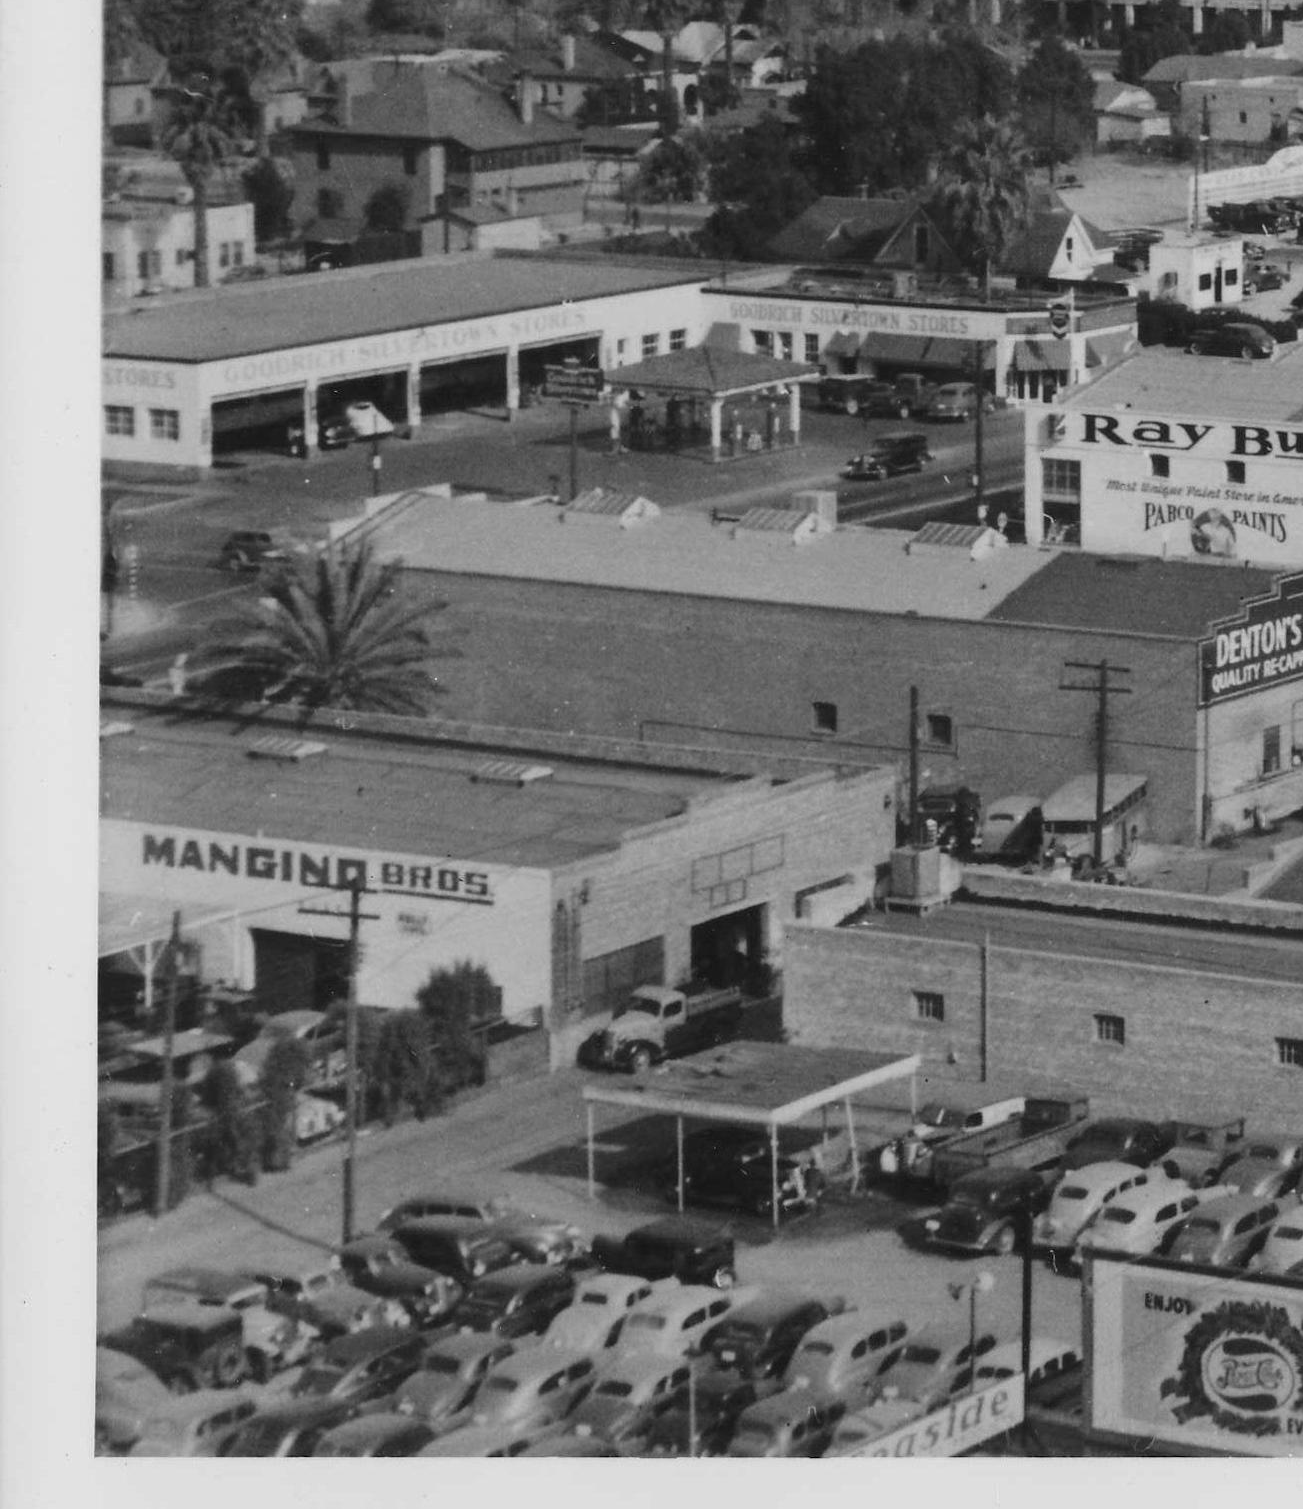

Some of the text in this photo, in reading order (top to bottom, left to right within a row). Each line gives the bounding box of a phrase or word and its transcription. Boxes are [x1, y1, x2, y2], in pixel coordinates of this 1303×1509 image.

[730, 301, 802, 323] GOODRICH
[908, 315, 969, 334] STORES
[224, 346, 346, 384] GOODRICH
[509, 311, 585, 335] STORES
[102, 368, 175, 389] STORES
[1081, 413, 1215, 451] Ray
[1141, 481, 1182, 498] Unique
[1224, 489, 1255, 501] Store
[1257, 491, 1271, 503] in
[1144, 501, 1287, 543] PABCO PAINTS
[1215, 613, 1303, 669] DENTON'S
[1211, 661, 1261, 694] QUALITY
[143, 834, 367, 891] MANGINO
[1143, 1291, 1195, 1316] ENJOY
